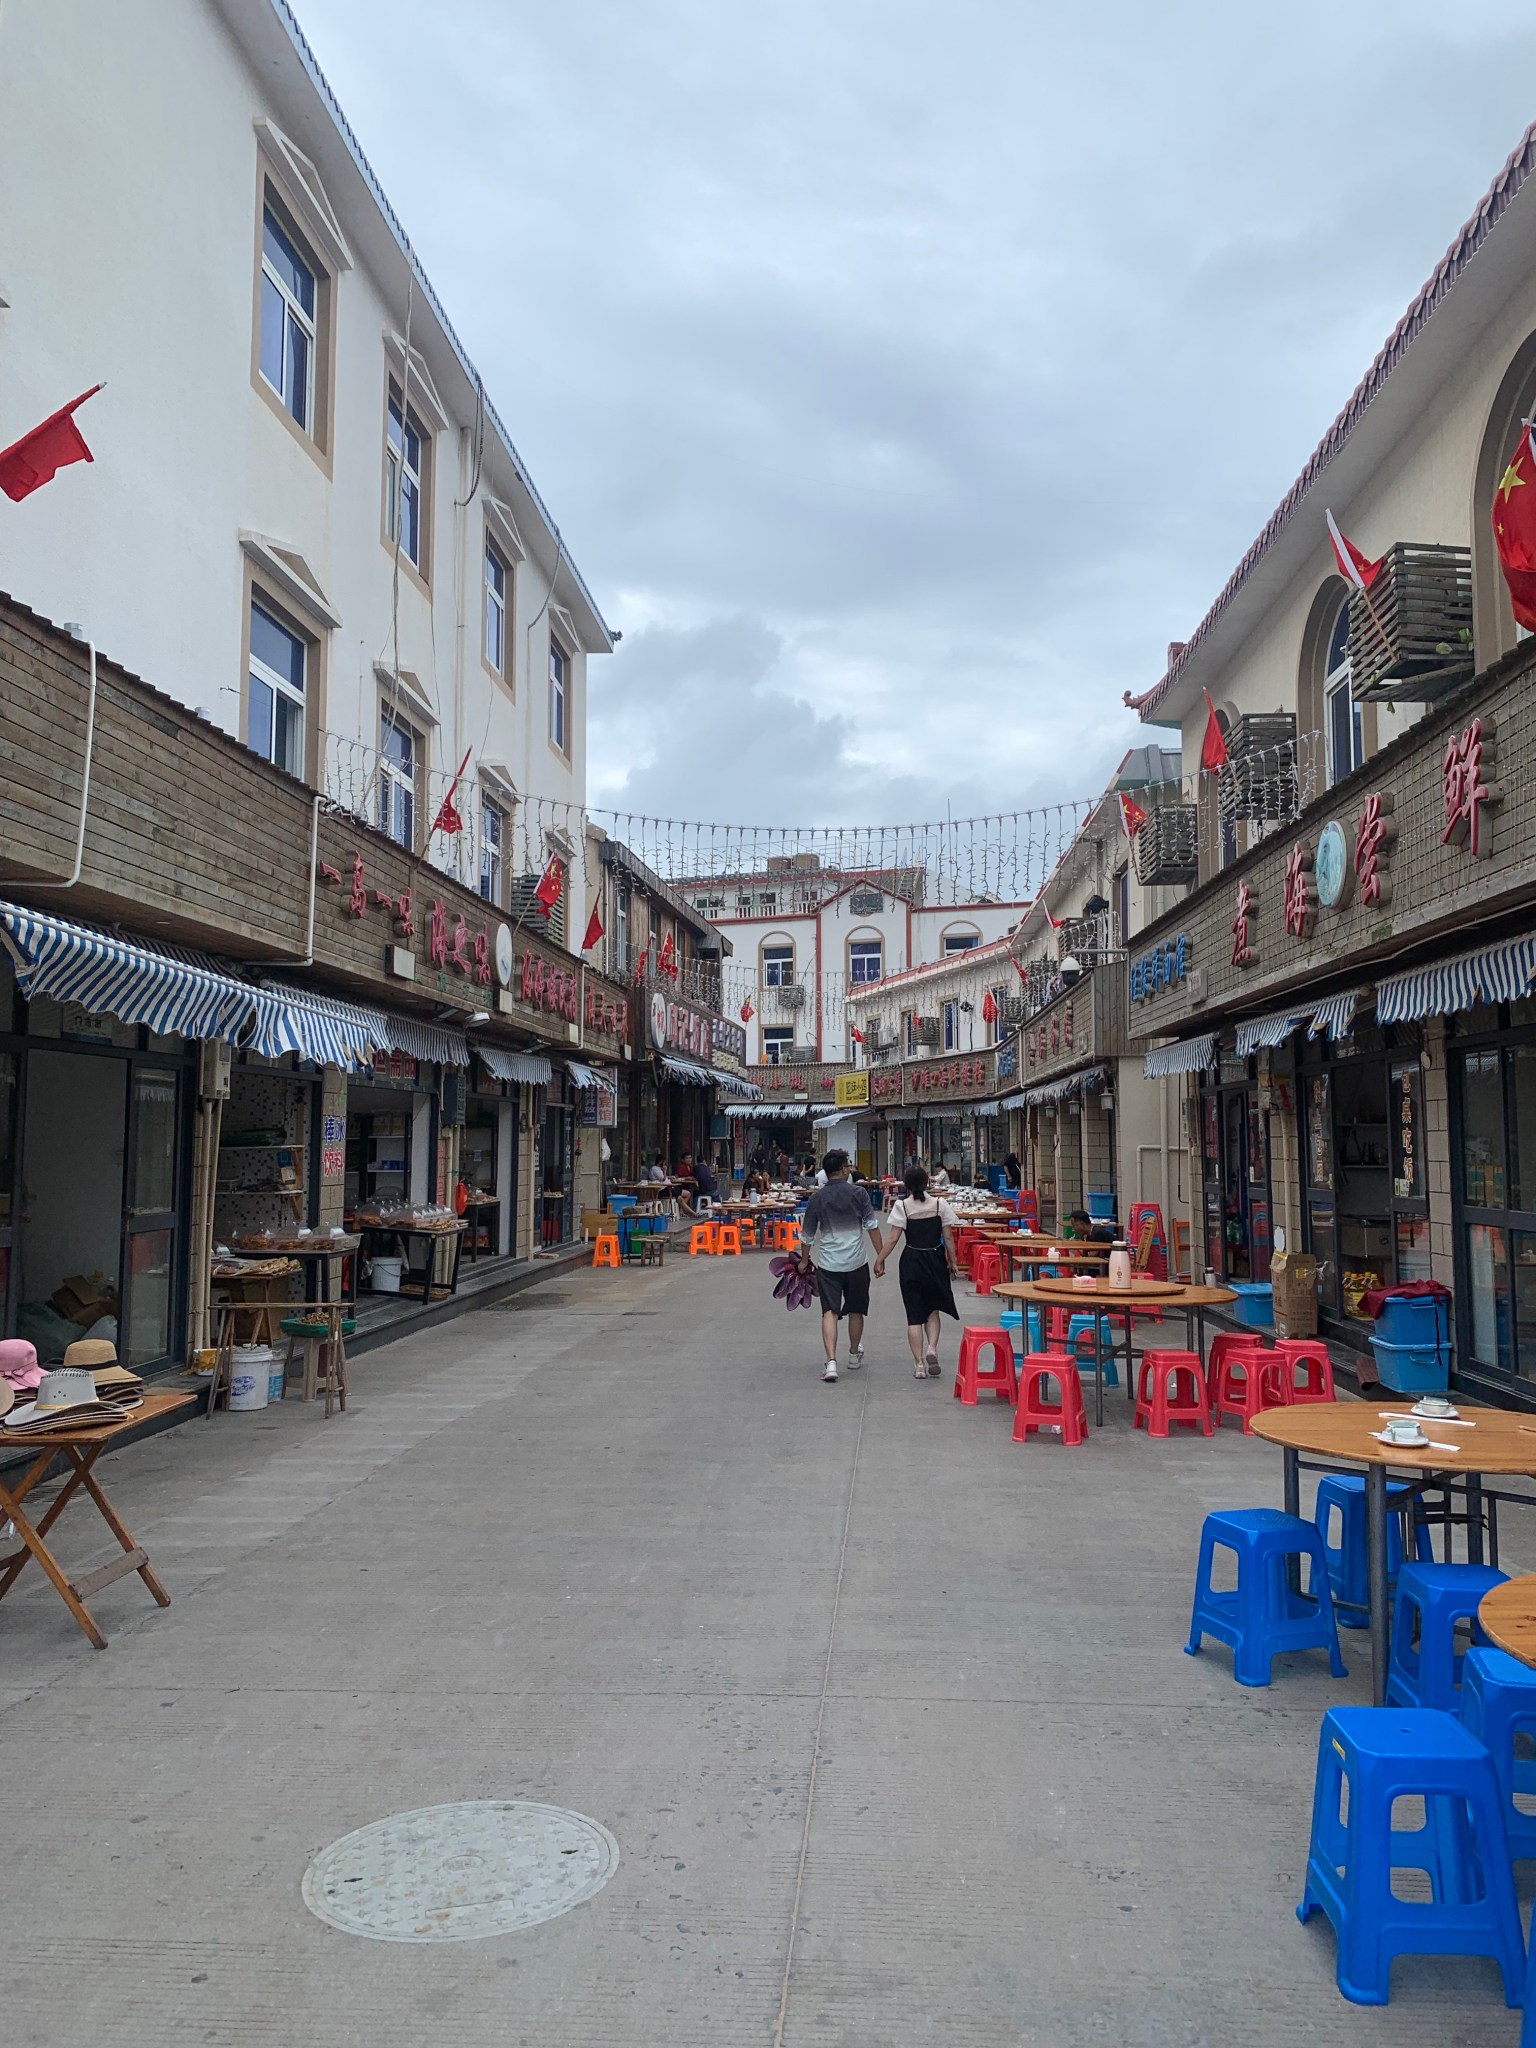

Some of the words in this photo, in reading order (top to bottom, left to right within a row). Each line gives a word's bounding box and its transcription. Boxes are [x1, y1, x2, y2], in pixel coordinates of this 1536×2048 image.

[323, 1148, 344, 1177] 饮料
[1401, 1069, 1414, 1184] 包桌吃饭
